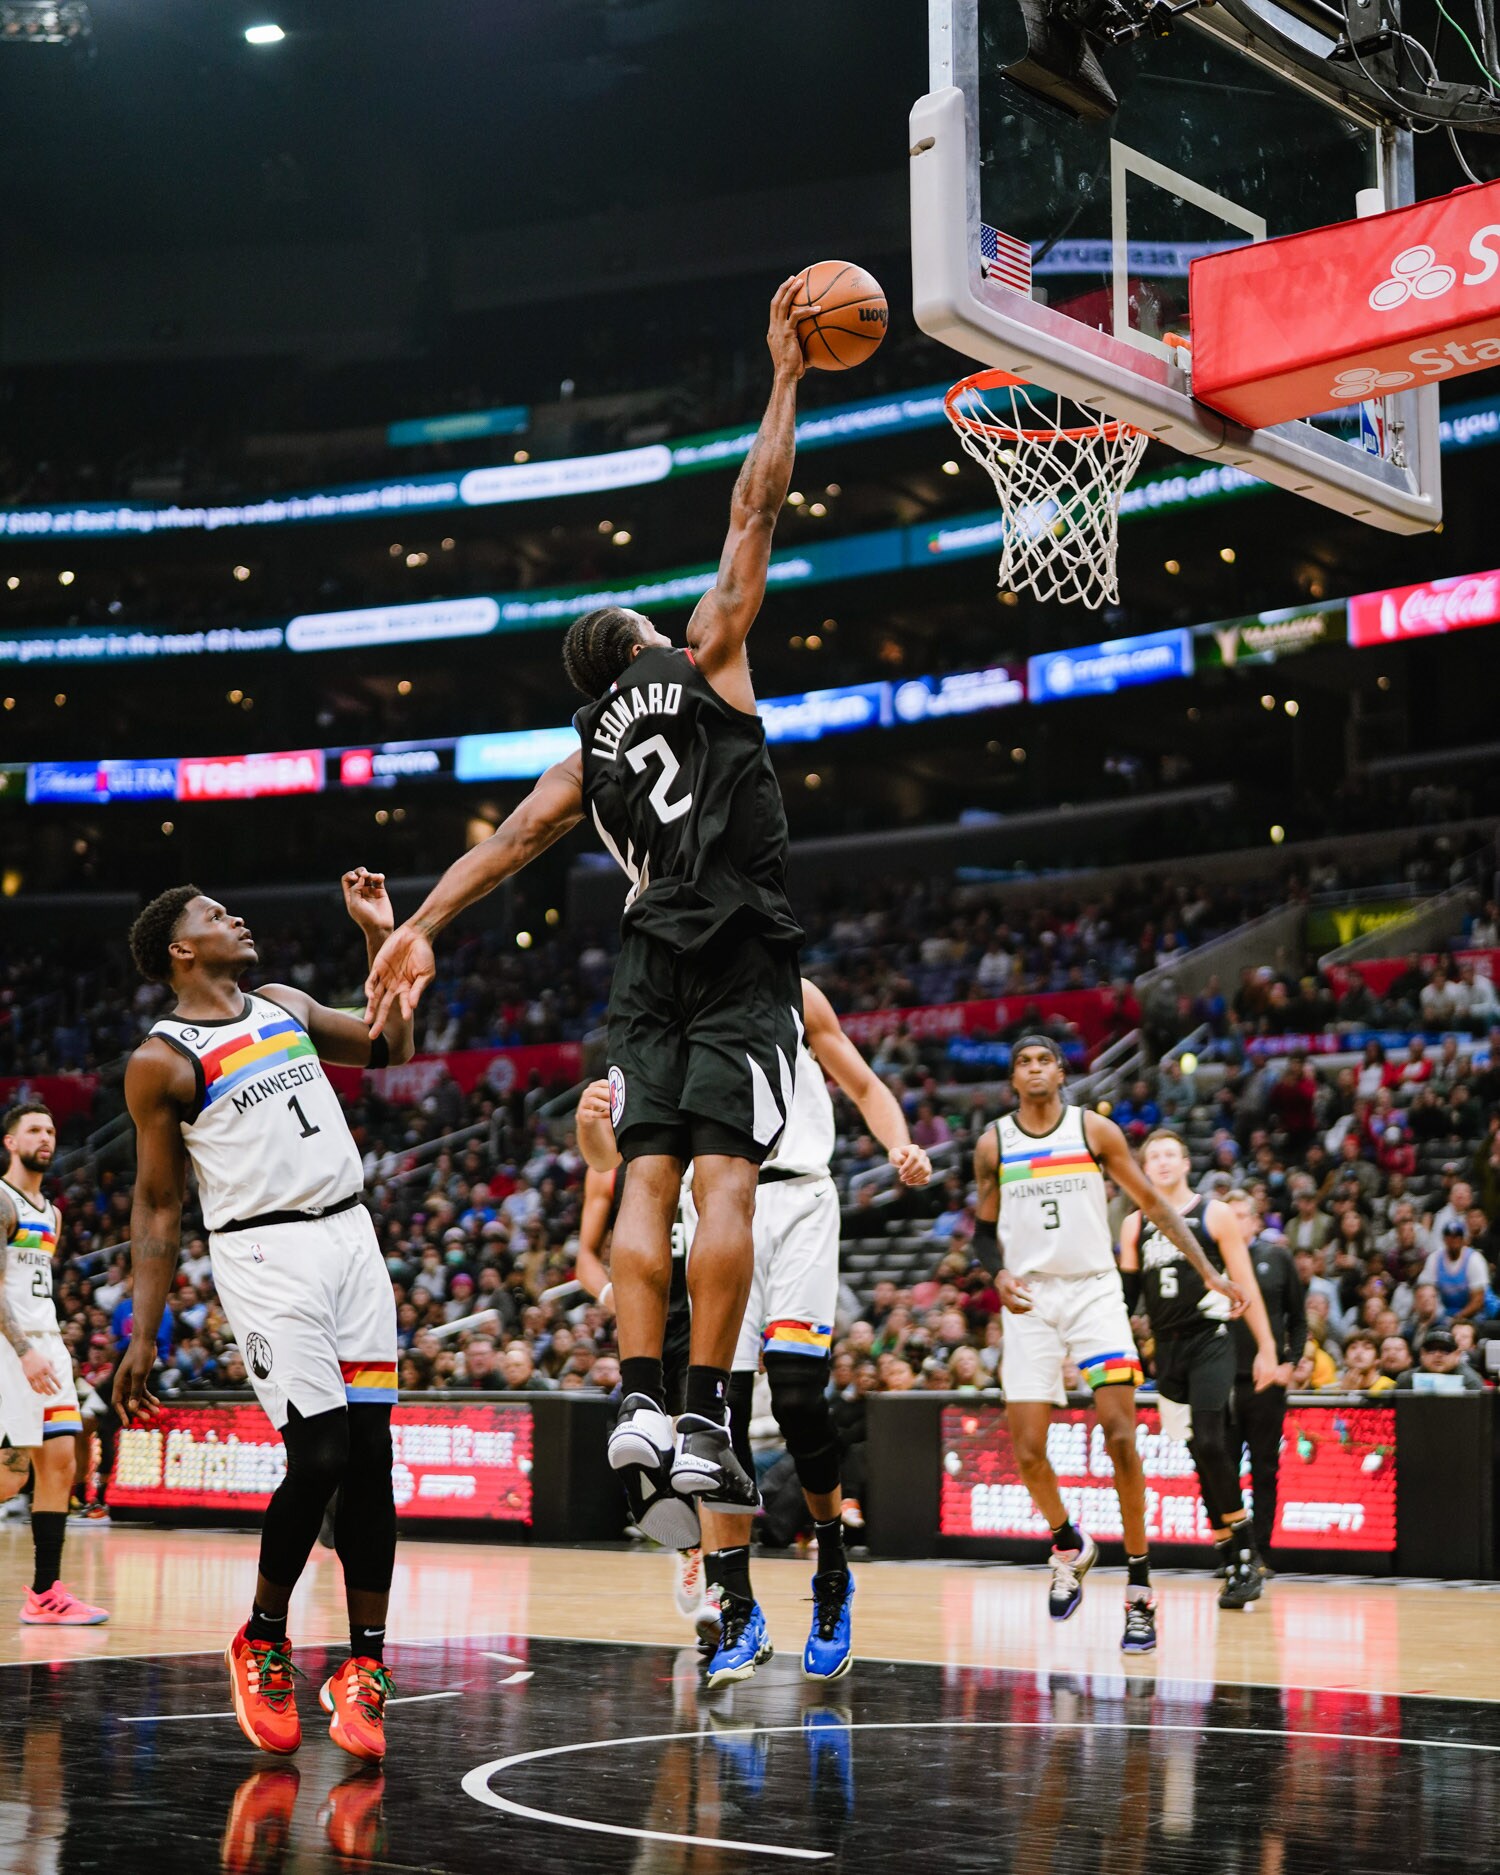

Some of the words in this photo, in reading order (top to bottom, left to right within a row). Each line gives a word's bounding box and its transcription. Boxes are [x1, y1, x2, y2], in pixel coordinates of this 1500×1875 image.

[592, 682, 682, 761] LEONARD
[186, 757, 314, 795] TOSHIBA
[625, 733, 693, 825] 2
[287, 1094, 321, 1139] 1
[1008, 1178, 1088, 1199] MINNESOTA
[1040, 1199, 1061, 1230] 3
[1159, 1266, 1178, 1299] 5
[1280, 1501, 1366, 1532] ESPN
